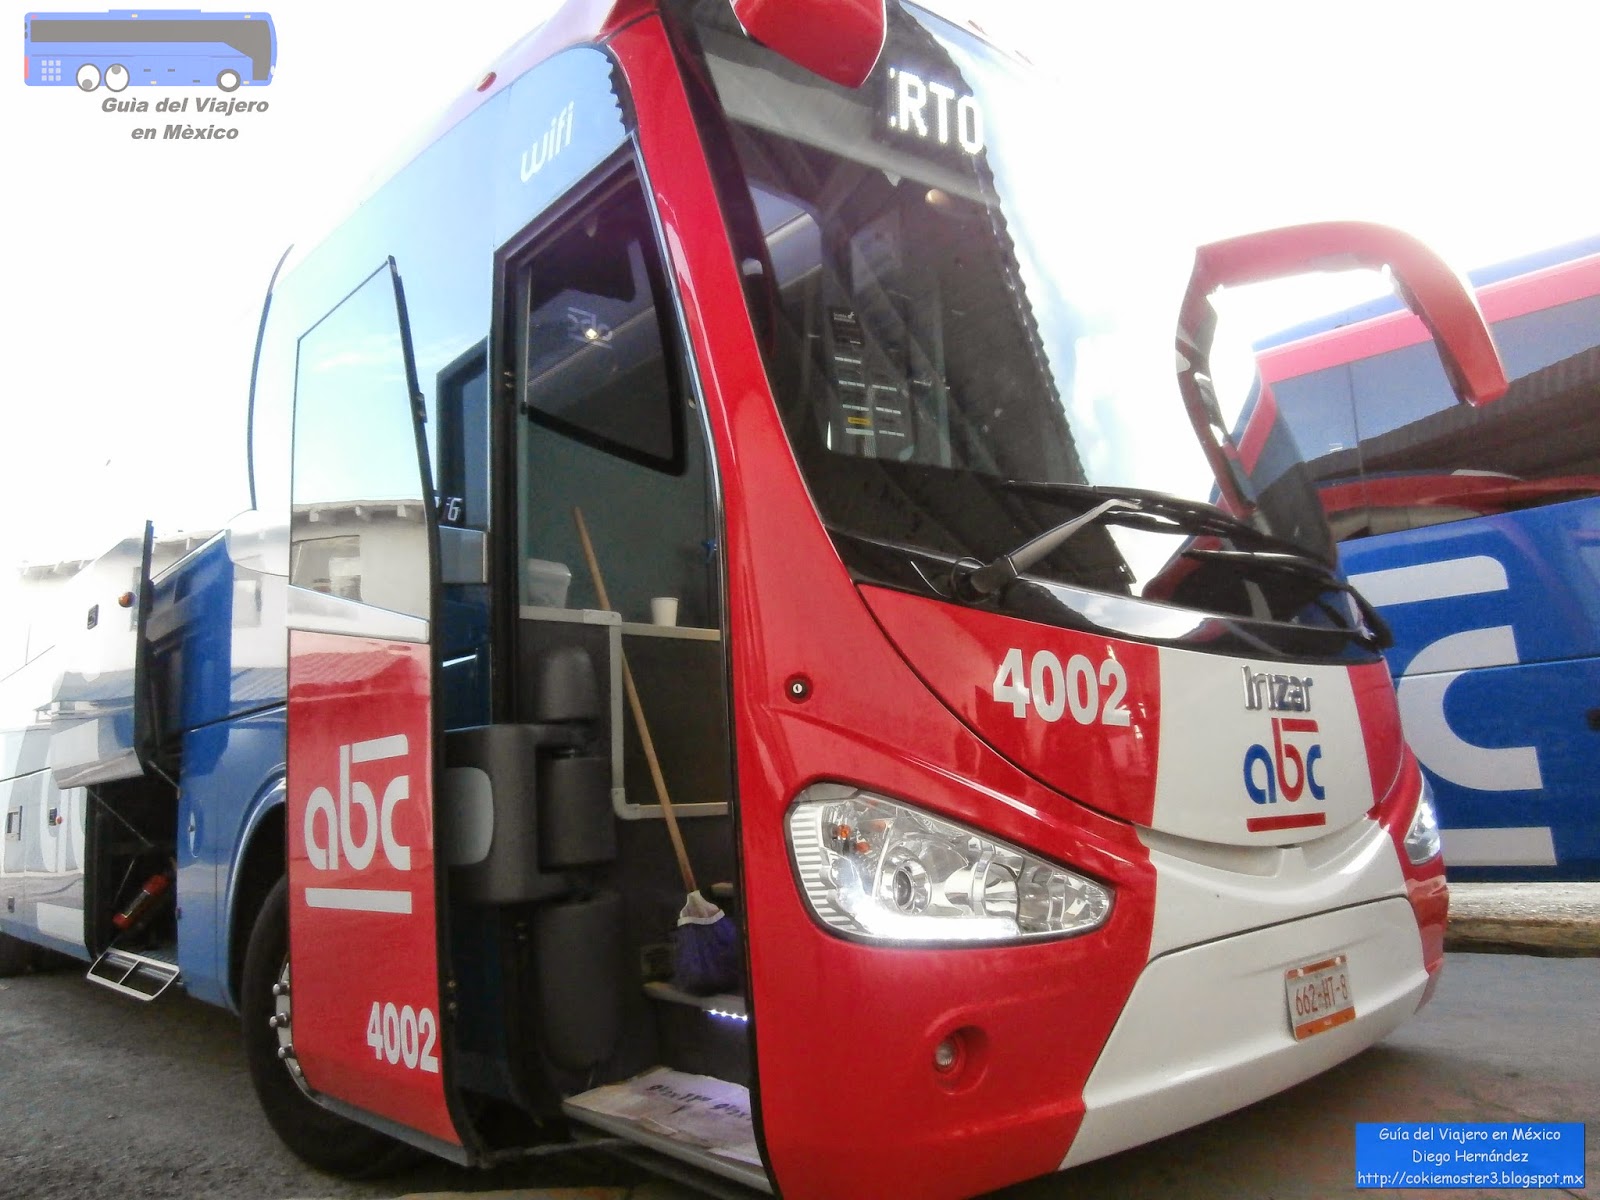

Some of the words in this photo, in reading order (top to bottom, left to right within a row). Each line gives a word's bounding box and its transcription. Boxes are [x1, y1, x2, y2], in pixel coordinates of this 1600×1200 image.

[520, 100, 575, 183] wifi
[888, 67, 984, 155] RTO
[993, 648, 1132, 727] 4002
[1241, 665, 1313, 712] Irizar
[303, 733, 412, 871] abc
[1243, 717, 1326, 805] abc
[366, 1001, 439, 1074] 4002
